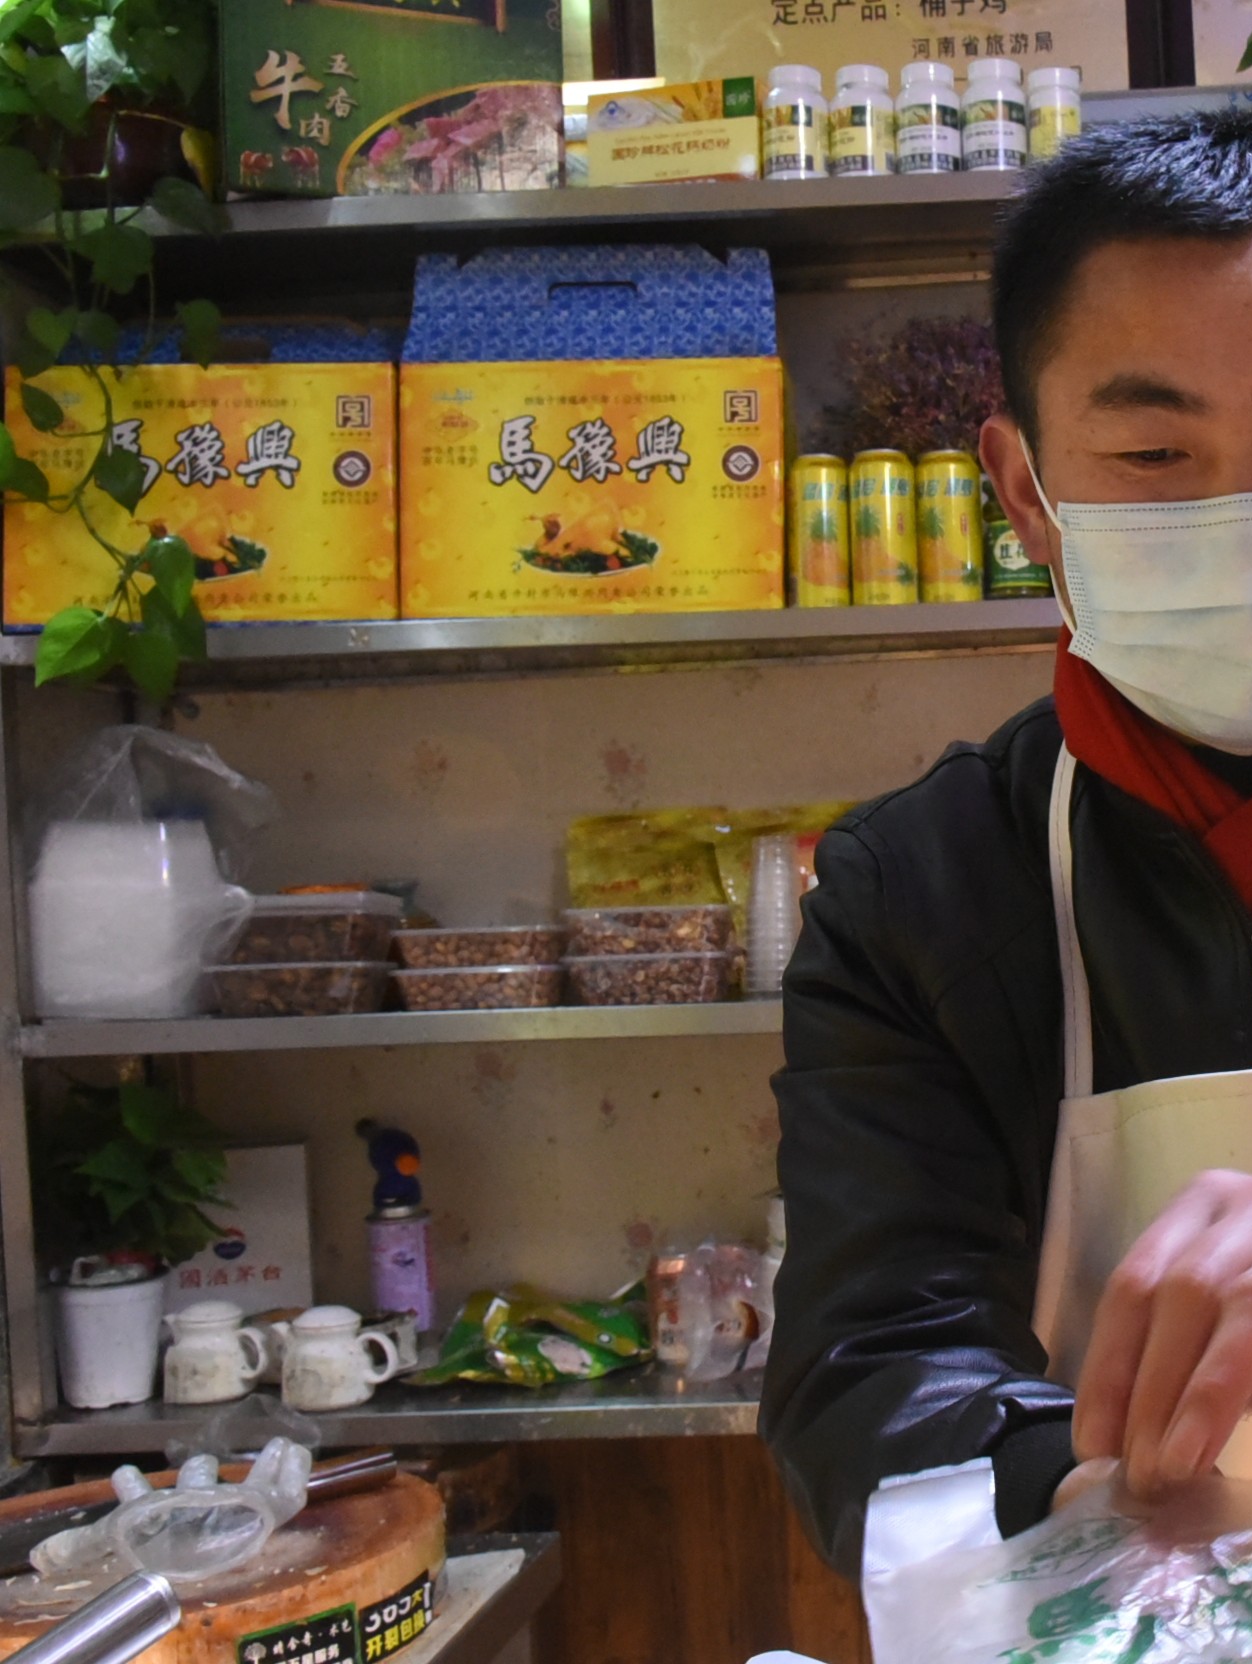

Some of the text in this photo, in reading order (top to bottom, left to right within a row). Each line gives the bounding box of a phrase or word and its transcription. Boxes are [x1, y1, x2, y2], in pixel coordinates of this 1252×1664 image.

[912, 31, 1053, 60] 河南省旅游局
[323, 52, 358, 119] 五香
[488, 415, 691, 494] 馬豫興
